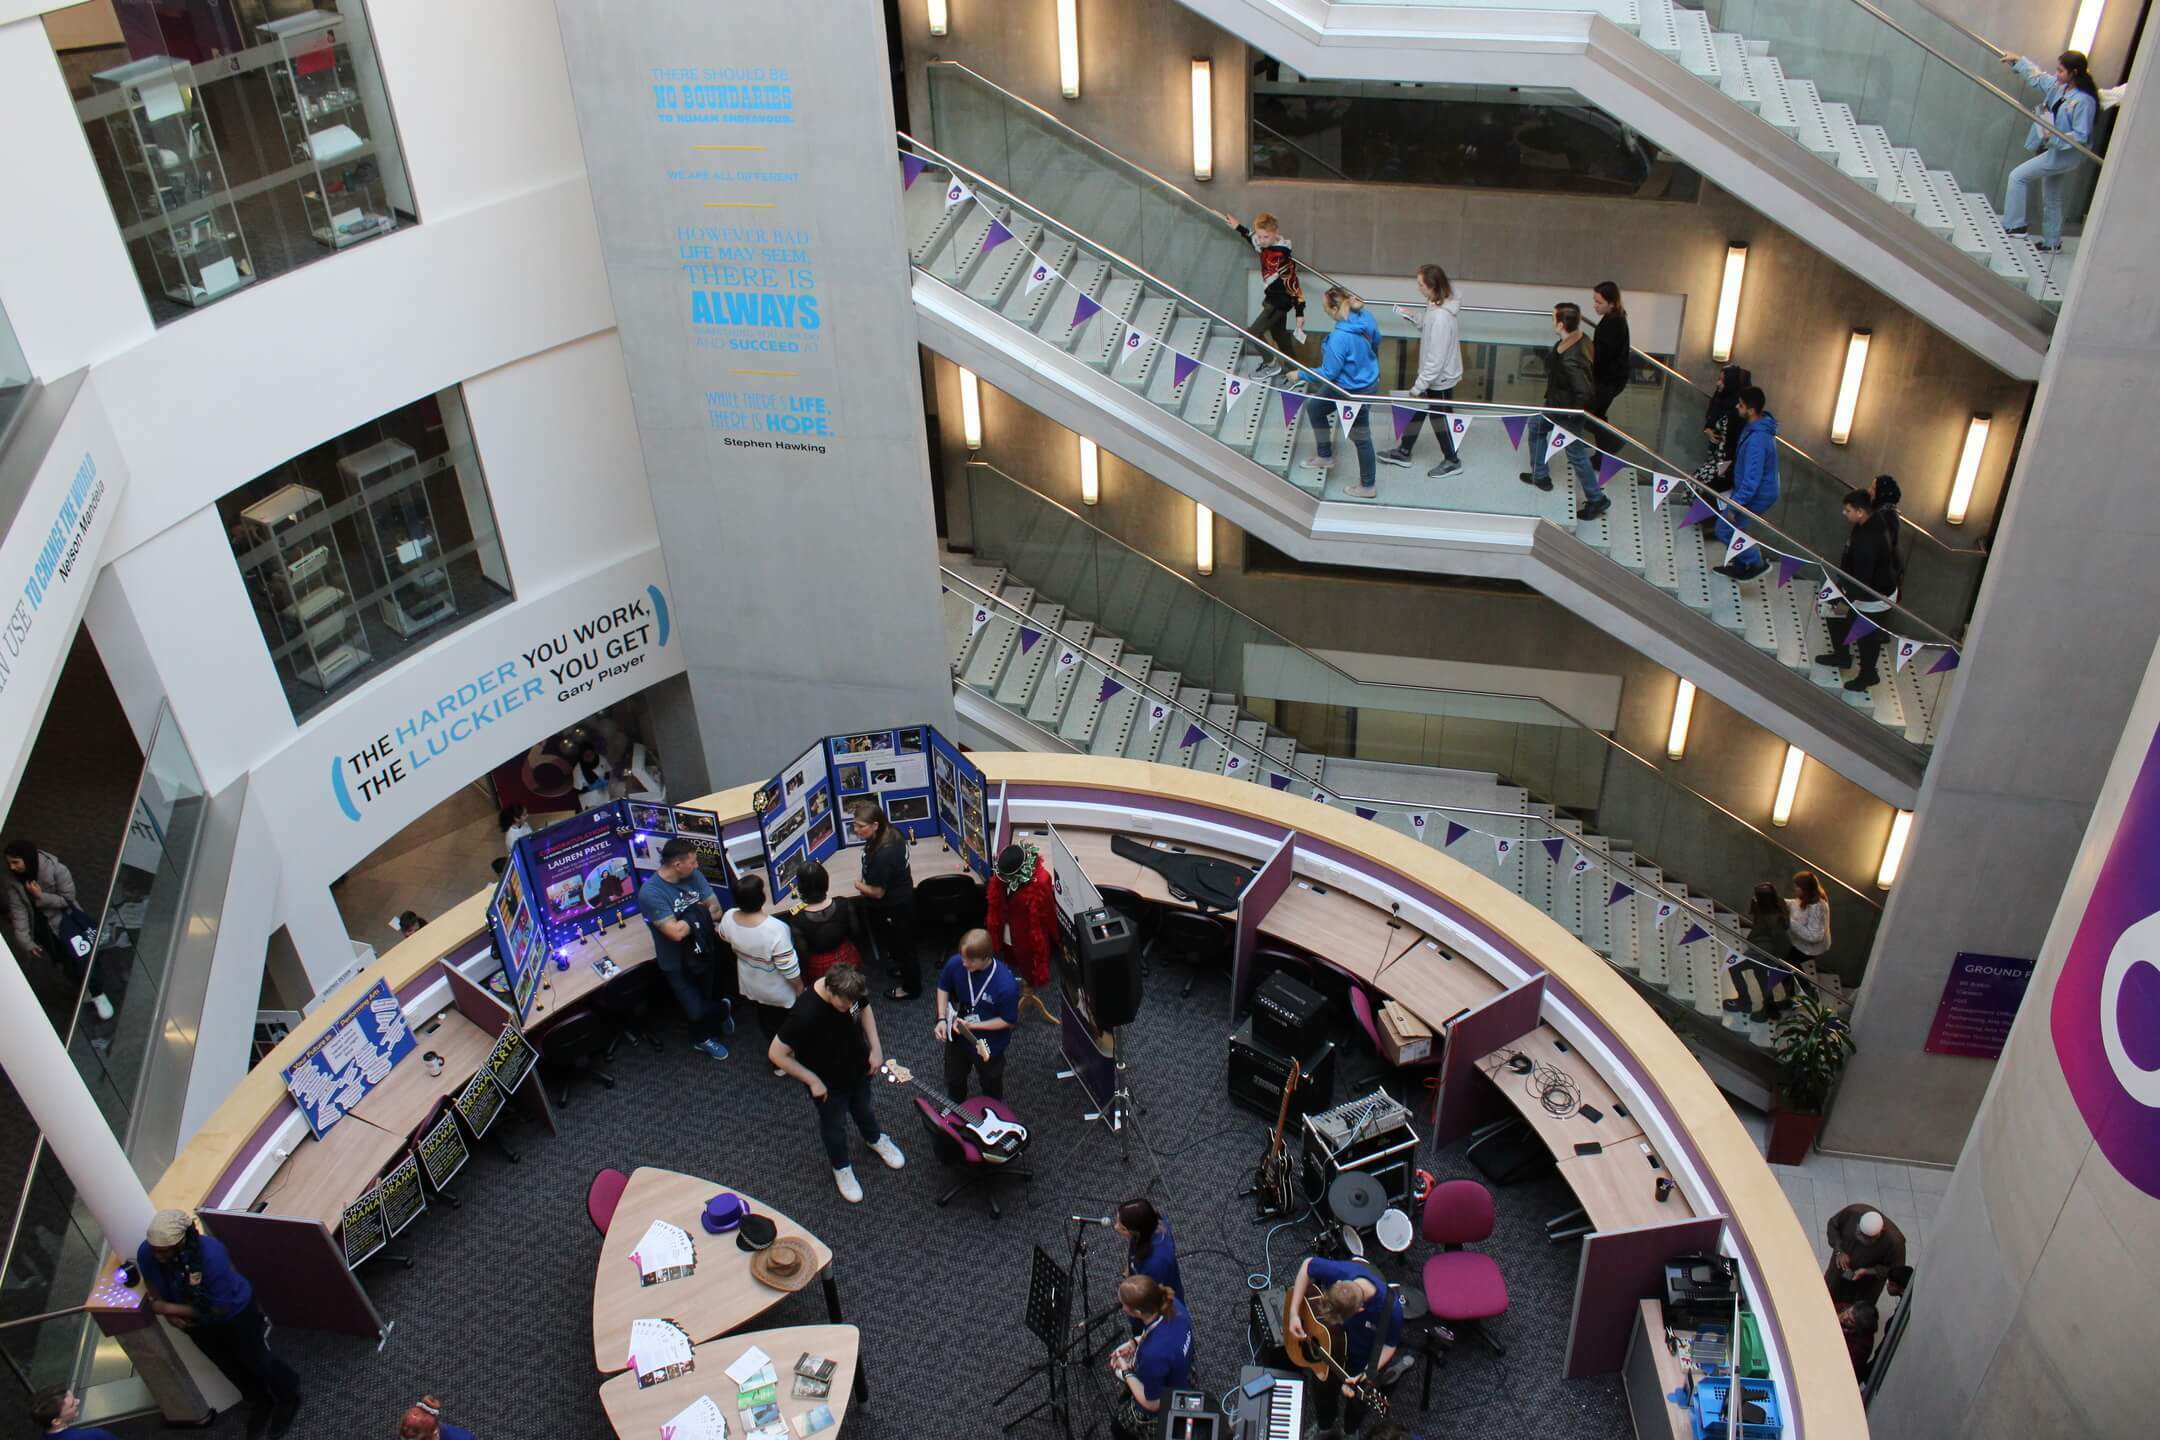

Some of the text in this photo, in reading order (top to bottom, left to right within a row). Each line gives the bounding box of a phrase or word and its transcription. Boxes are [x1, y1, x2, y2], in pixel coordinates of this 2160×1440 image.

[679, 244, 714, 260] LIFE
[719, 247, 755, 261] MAY
[681, 264, 817, 290] THERE IS
[690, 290, 821, 330] ALWAYS
[729, 338, 800, 353] SUCCEED
[766, 414, 836, 437] HOPE.
[723, 437, 826, 454] Stephen Hawking
[58, 480, 105, 583] Nelson Mandela
[3, 599, 32, 657] USE
[347, 600, 650, 775] THE HARDER YOU WORK,
[557, 653, 646, 703] Gary Player
[357, 624, 651, 802] THE LUCKIER YOU GET
[547, 849, 583, 870] LAUREN
[584, 839, 612, 856] PATEL
[1964, 965, 2022, 977] GROUND
[487, 1026, 513, 1067] CHOOSE
[493, 1033, 519, 1072] ARTS
[459, 1068, 488, 1108] CHOOSE
[463, 1074, 492, 1114] DRAMA
[420, 1117, 452, 1151] CHOOSE
[423, 1123, 455, 1159] DRAMA
[381, 1158, 416, 1191] CHOOSE
[383, 1167, 417, 1199] DRAMA
[343, 1190, 380, 1219] CHOOSE
[345, 1199, 380, 1227] DRAMA
